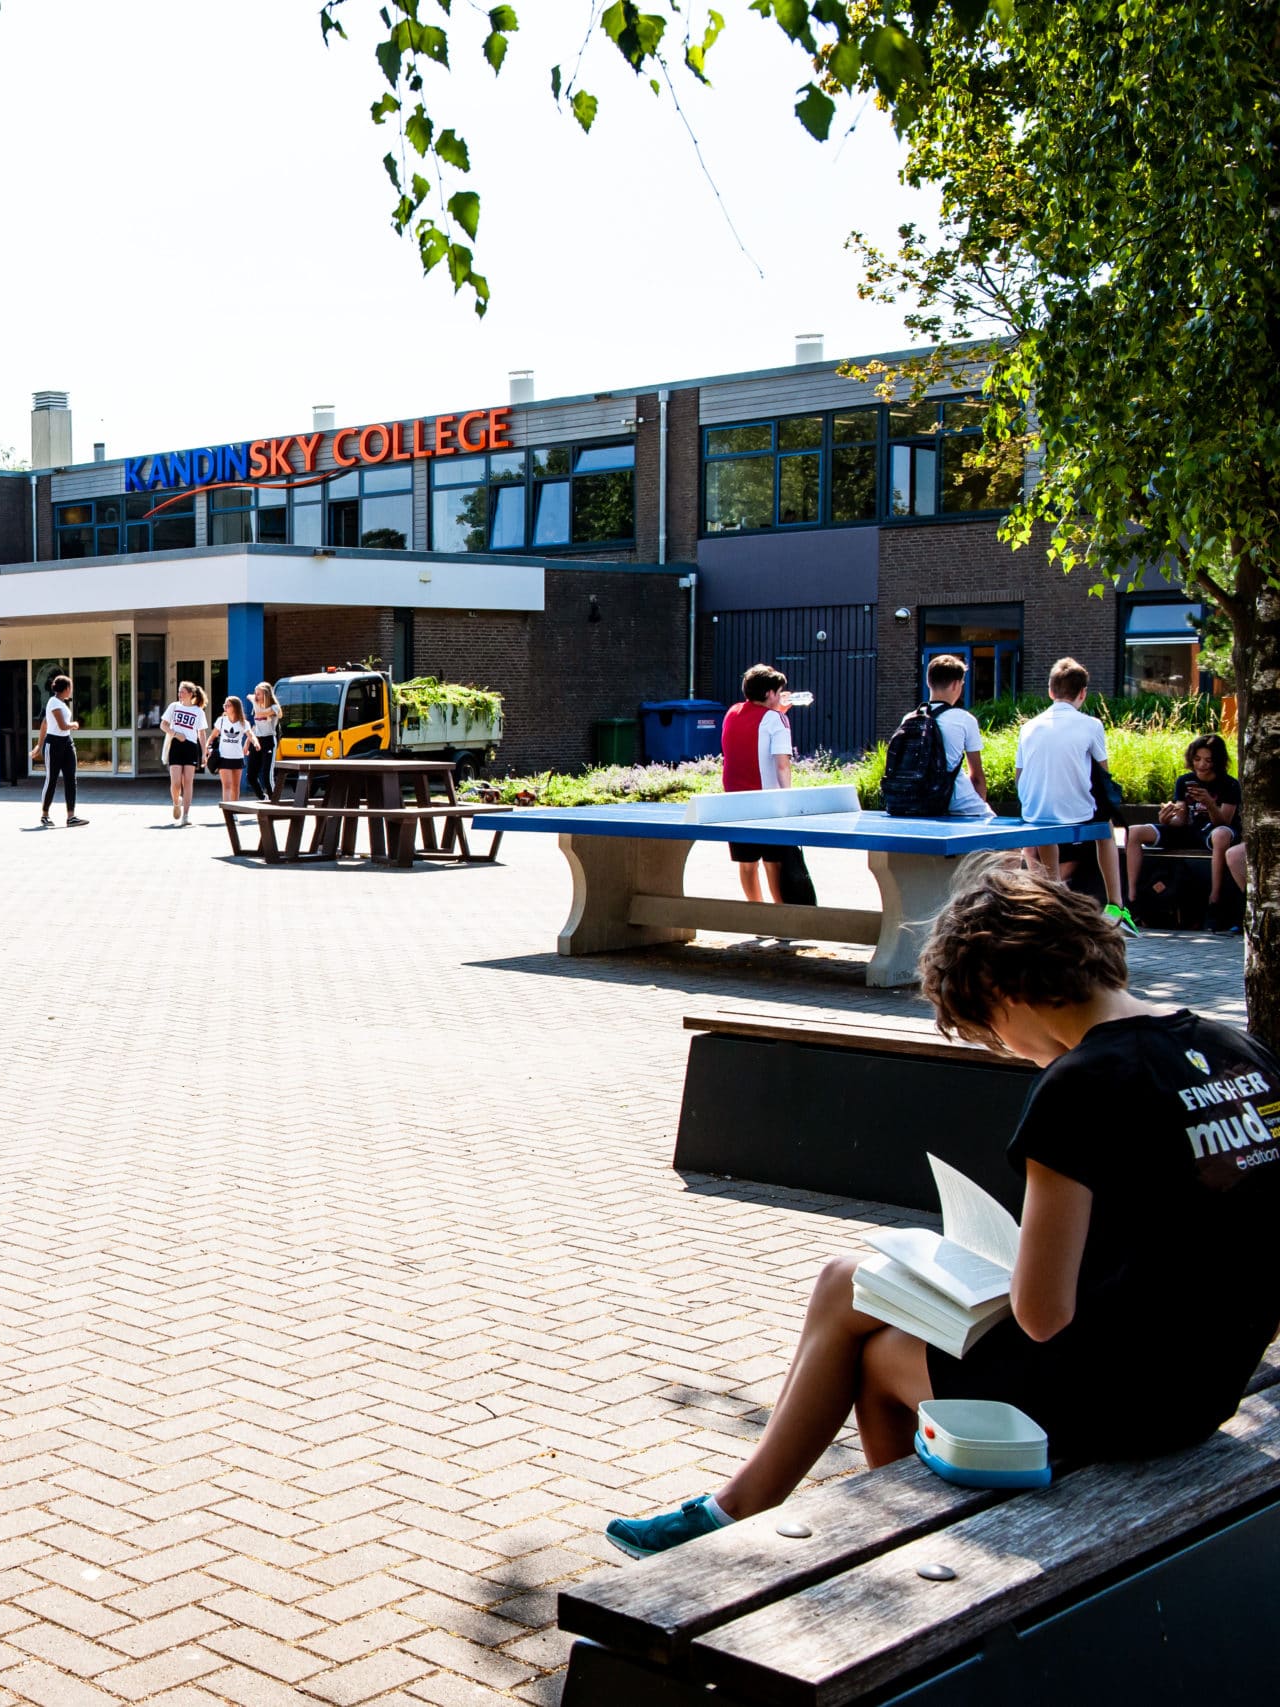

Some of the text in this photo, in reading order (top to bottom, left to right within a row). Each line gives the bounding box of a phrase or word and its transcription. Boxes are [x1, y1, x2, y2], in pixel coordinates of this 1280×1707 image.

[125, 407, 513, 493] KANDINSKY COLLEGE
[1178, 1072, 1270, 1111] FINISHER
[1186, 1101, 1272, 1159] mud
[1246, 1147, 1280, 1166] edition
